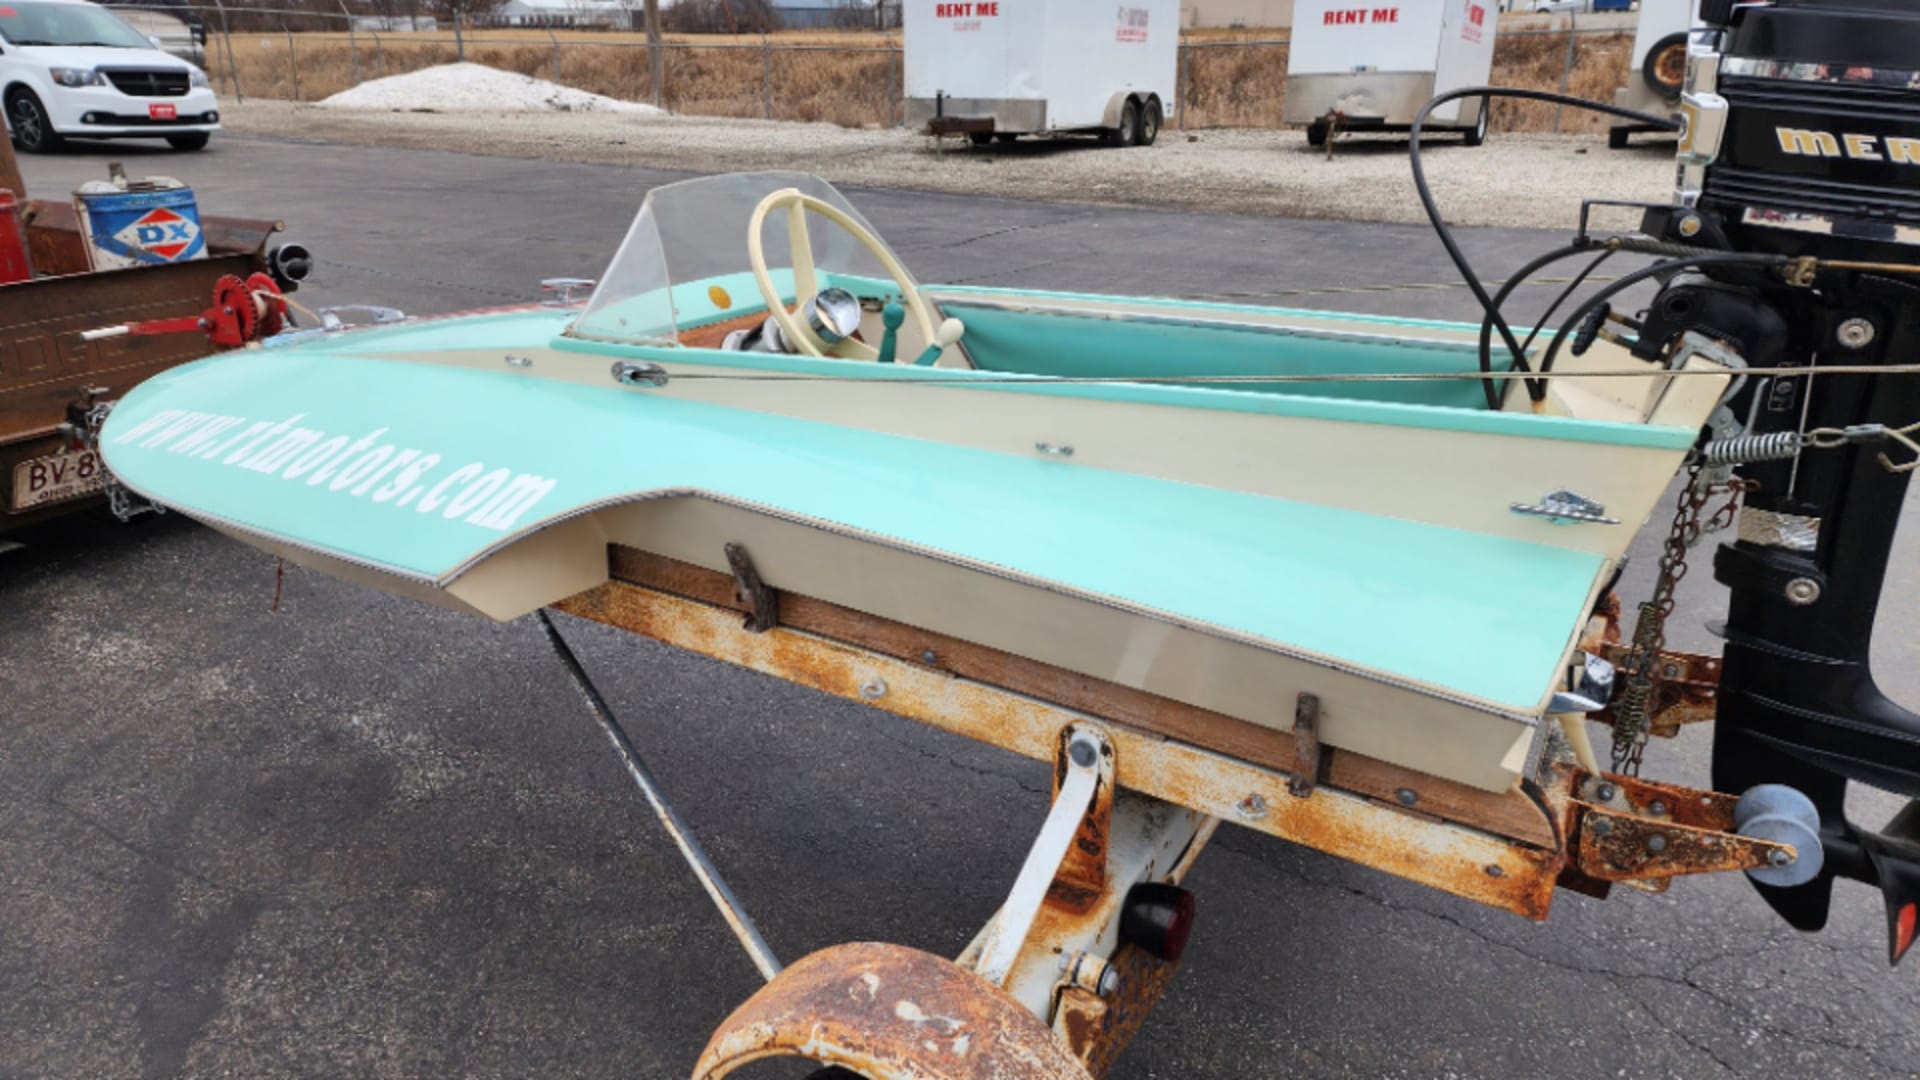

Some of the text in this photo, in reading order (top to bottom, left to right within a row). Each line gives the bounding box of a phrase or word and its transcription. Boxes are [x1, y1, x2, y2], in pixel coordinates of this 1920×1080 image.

[936, 2, 998, 18] RENT ME
[1323, 8, 1399, 25] RENT ME
[1776, 127, 1920, 164] MER
[136, 223, 191, 243] DX
[112, 409, 557, 531] www.rtmotors.com
